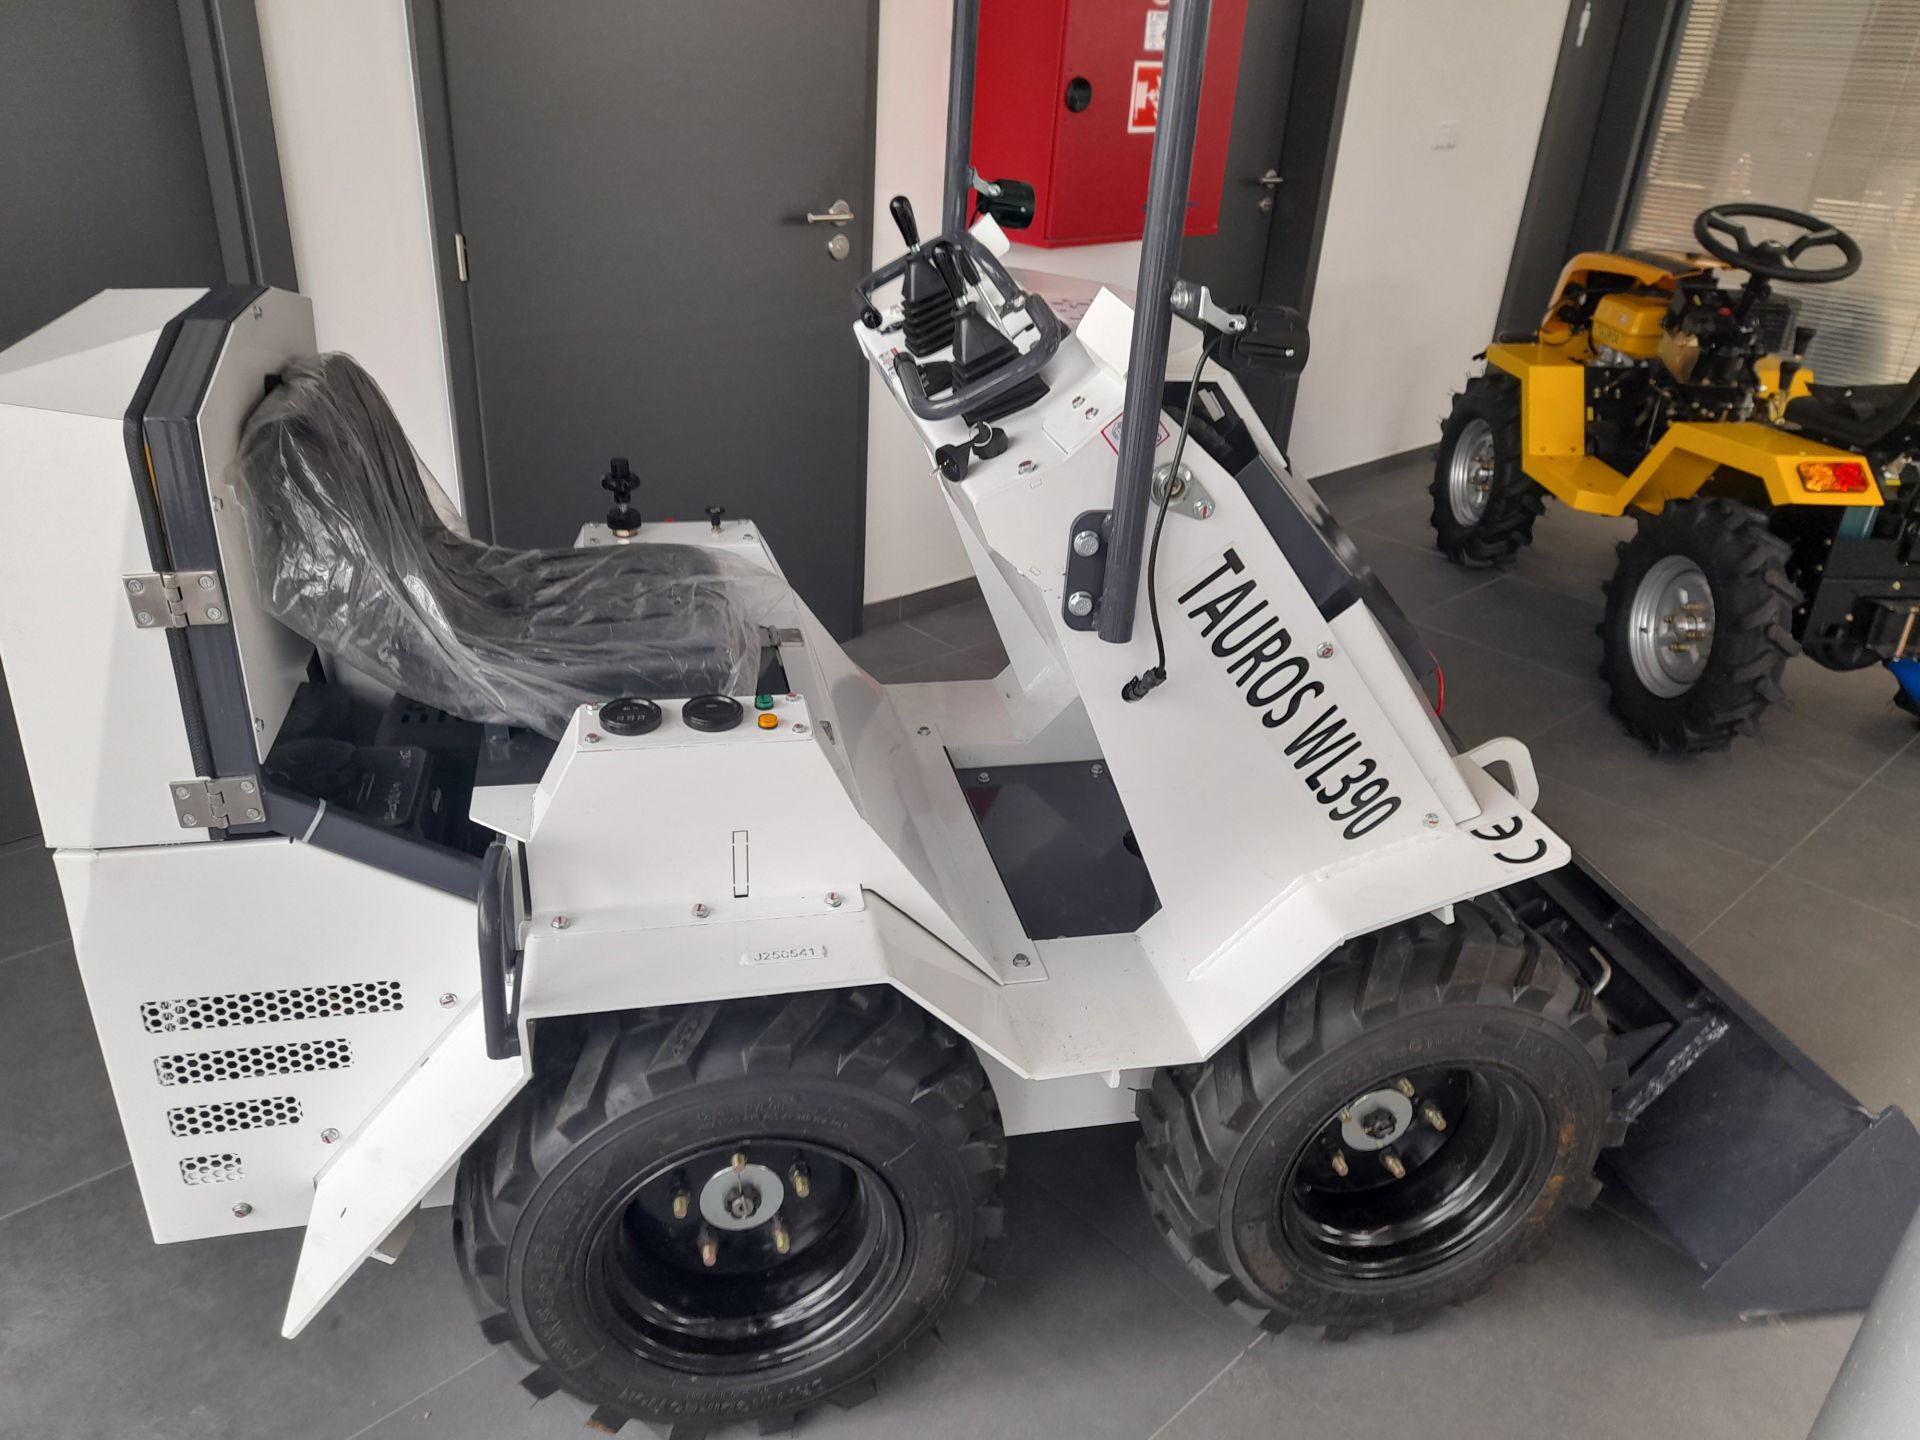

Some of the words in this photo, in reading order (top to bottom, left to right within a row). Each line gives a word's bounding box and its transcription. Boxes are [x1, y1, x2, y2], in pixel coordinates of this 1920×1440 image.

[1177, 547, 1325, 729] TAUROS
[1283, 704, 1402, 841] WL390
[1469, 815, 1548, 865] CE
